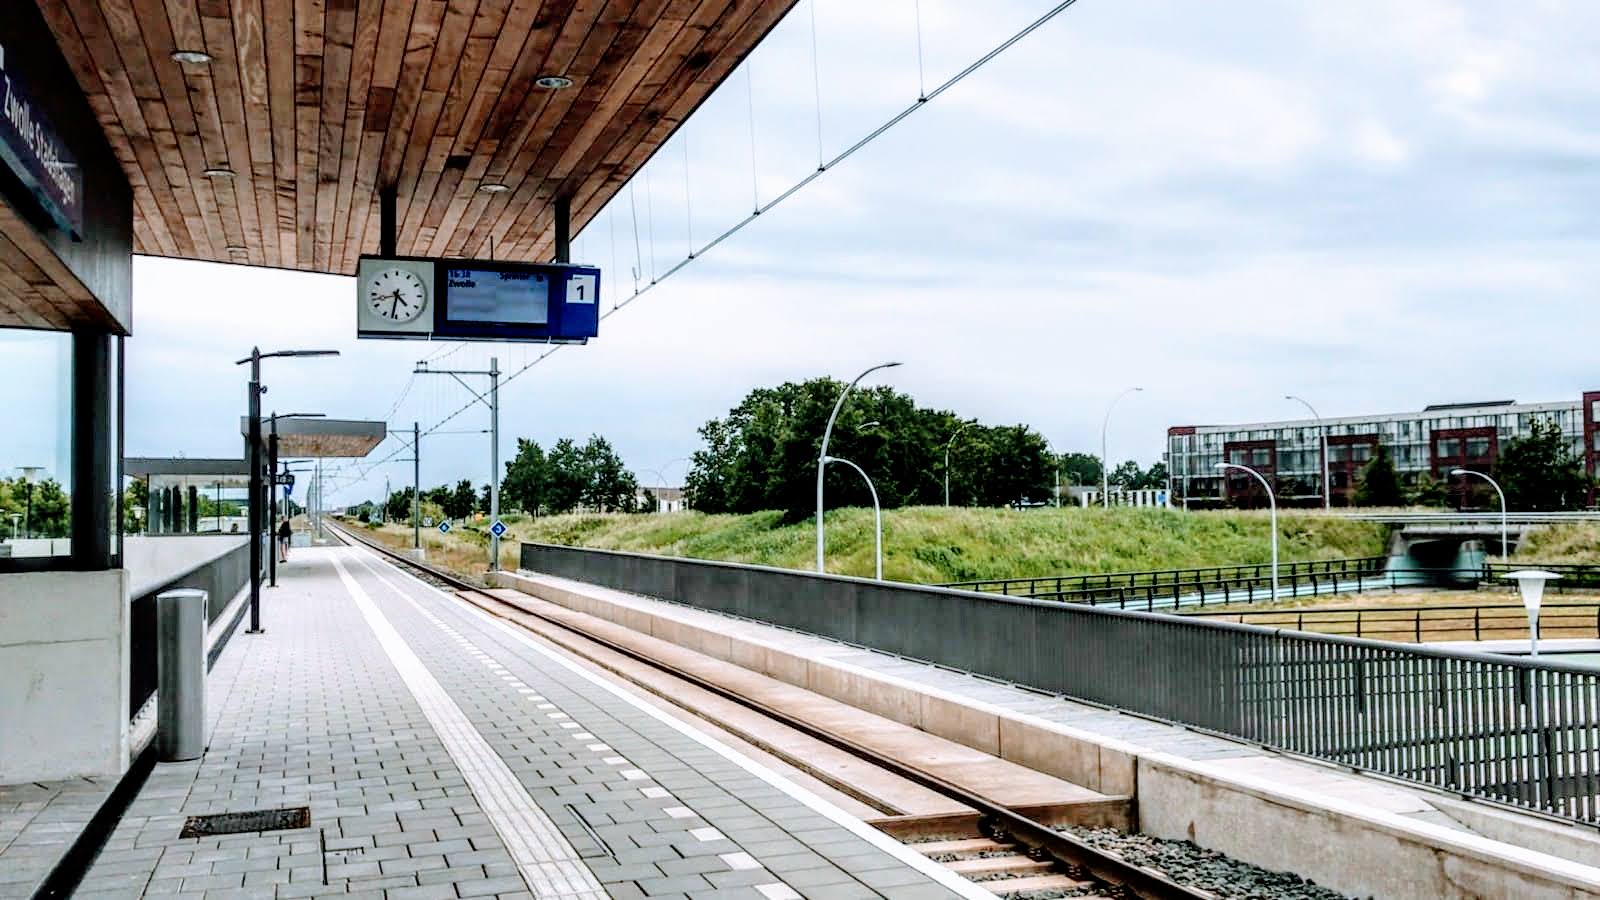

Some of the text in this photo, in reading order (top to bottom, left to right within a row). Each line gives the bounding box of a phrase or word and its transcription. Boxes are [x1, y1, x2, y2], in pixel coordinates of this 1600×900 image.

[4, 74, 34, 150] Zwolle
[448, 279, 476, 288] Zwolle
[576, 285, 584, 300] 1
